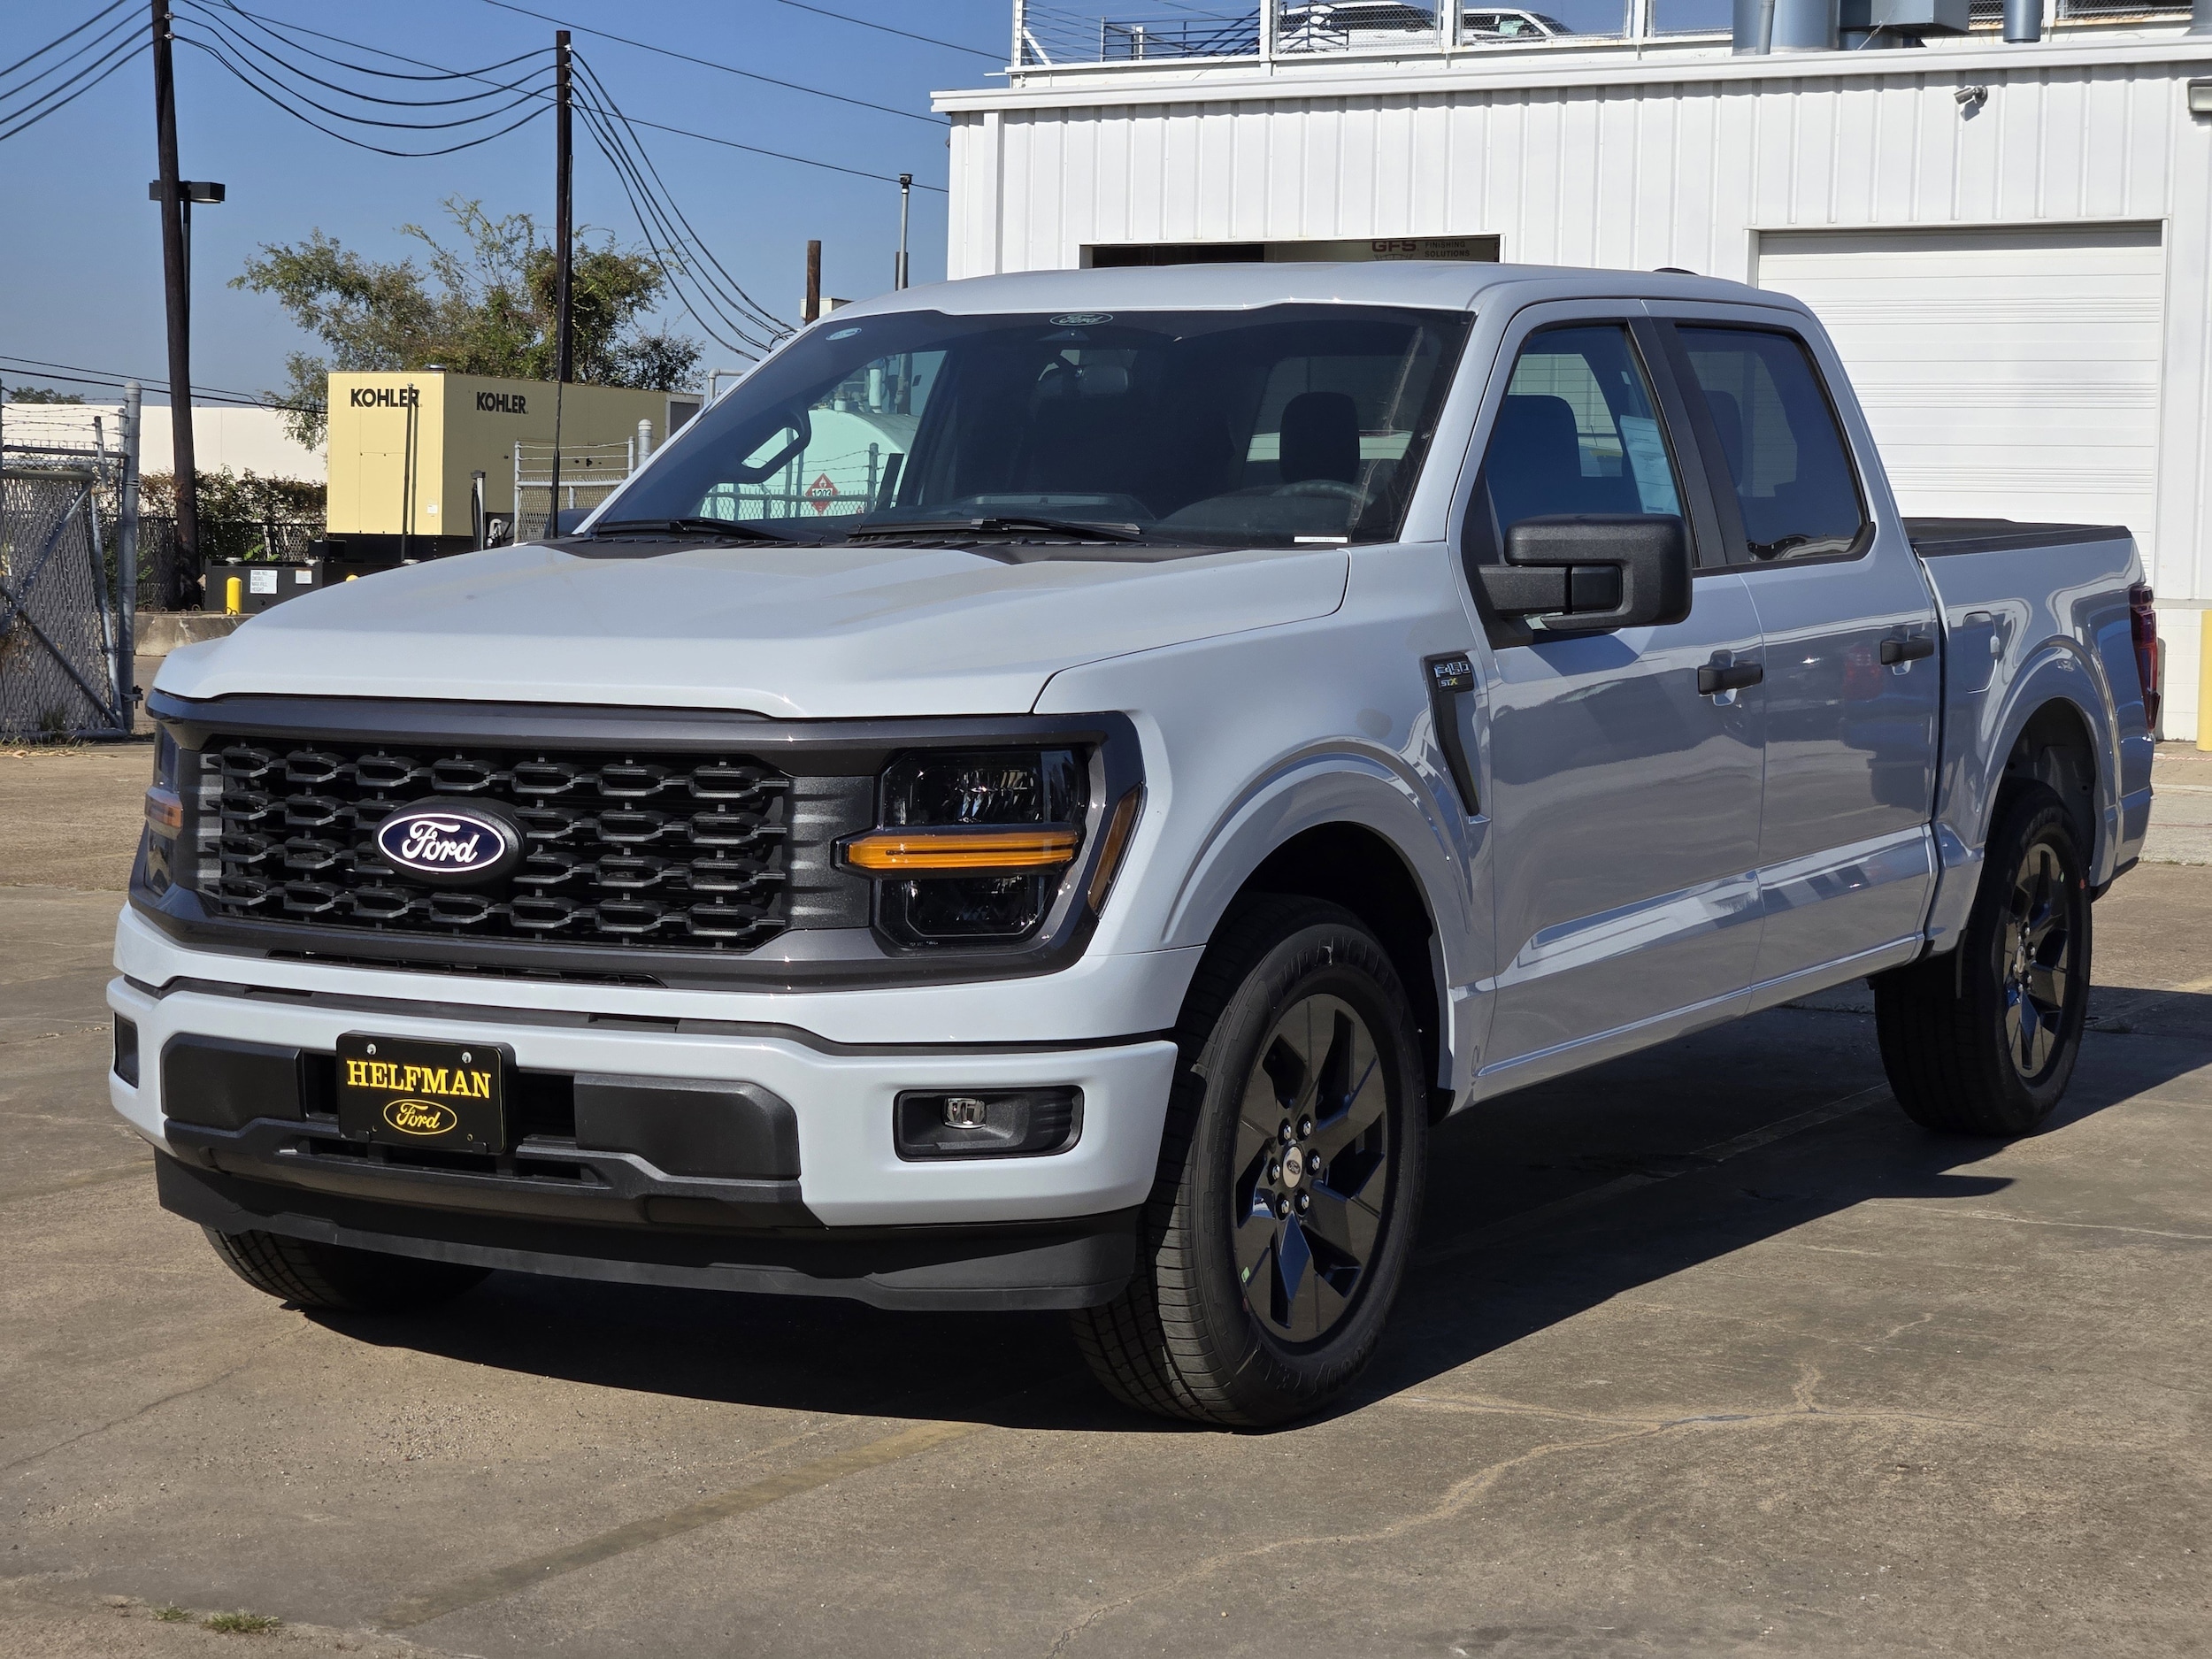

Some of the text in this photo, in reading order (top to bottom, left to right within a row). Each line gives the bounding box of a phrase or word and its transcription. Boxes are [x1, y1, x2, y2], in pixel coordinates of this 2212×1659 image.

[1372, 241, 1416, 252] GFS
[350, 388, 420, 408] KOHLER
[476, 391, 526, 414] KOHLER
[1440, 678, 1458, 687] STX
[402, 821, 480, 864] Ford
[347, 1060, 491, 1099] HELFMAN
[396, 1102, 442, 1129] Ford
